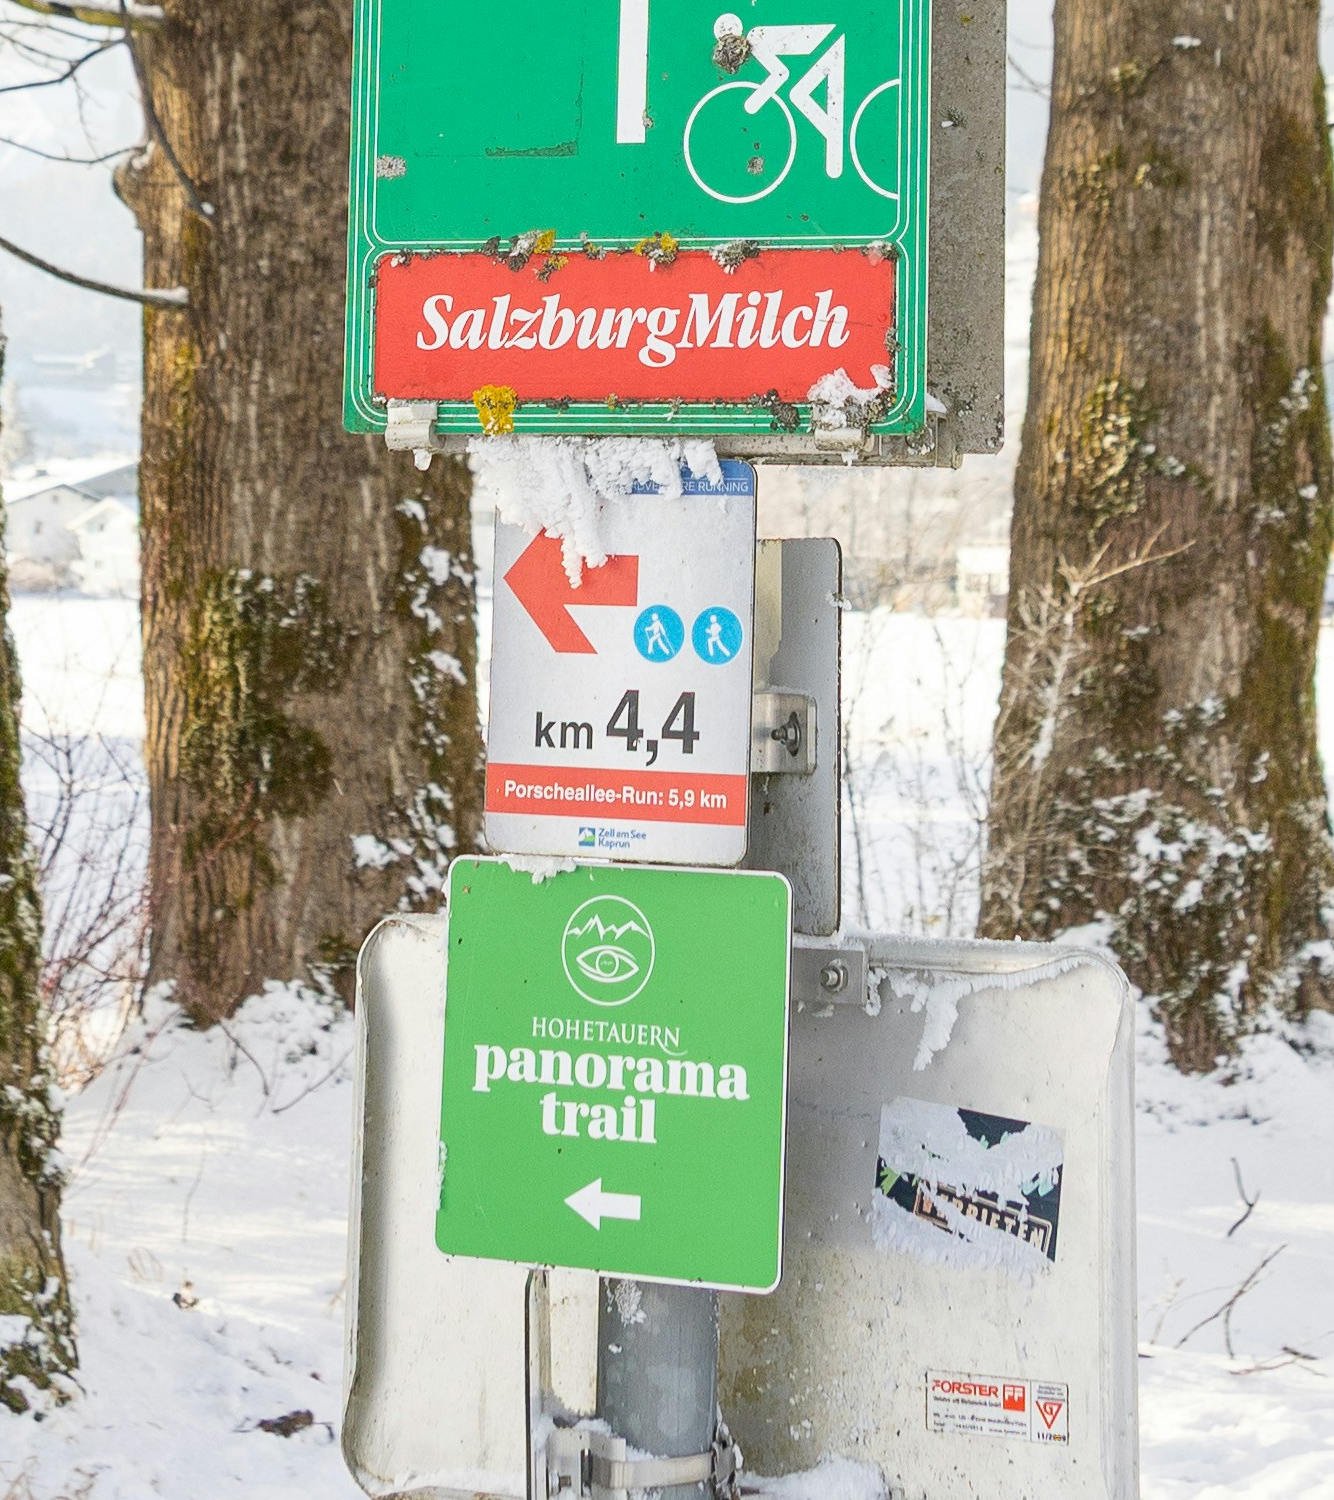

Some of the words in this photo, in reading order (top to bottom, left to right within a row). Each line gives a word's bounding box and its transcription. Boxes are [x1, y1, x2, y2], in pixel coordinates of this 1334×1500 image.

[416, 288, 851, 368] SalzburgMilch
[697, 481, 749, 493] RUNNING
[535, 711, 593, 750] km
[605, 689, 701, 767] 4,4
[504, 779, 664, 806] Porscheallee-Run:
[668, 788, 696, 809] 5,9
[700, 789, 728, 809] km
[598, 828, 615, 838] Zell
[616, 831, 629, 839] am
[630, 829, 647, 840] See
[598, 838, 630, 850] Kaprun
[471, 1043, 751, 1101] panorama
[539, 1091, 658, 1145] trail
[931, 1378, 1000, 1400] FORSTER
